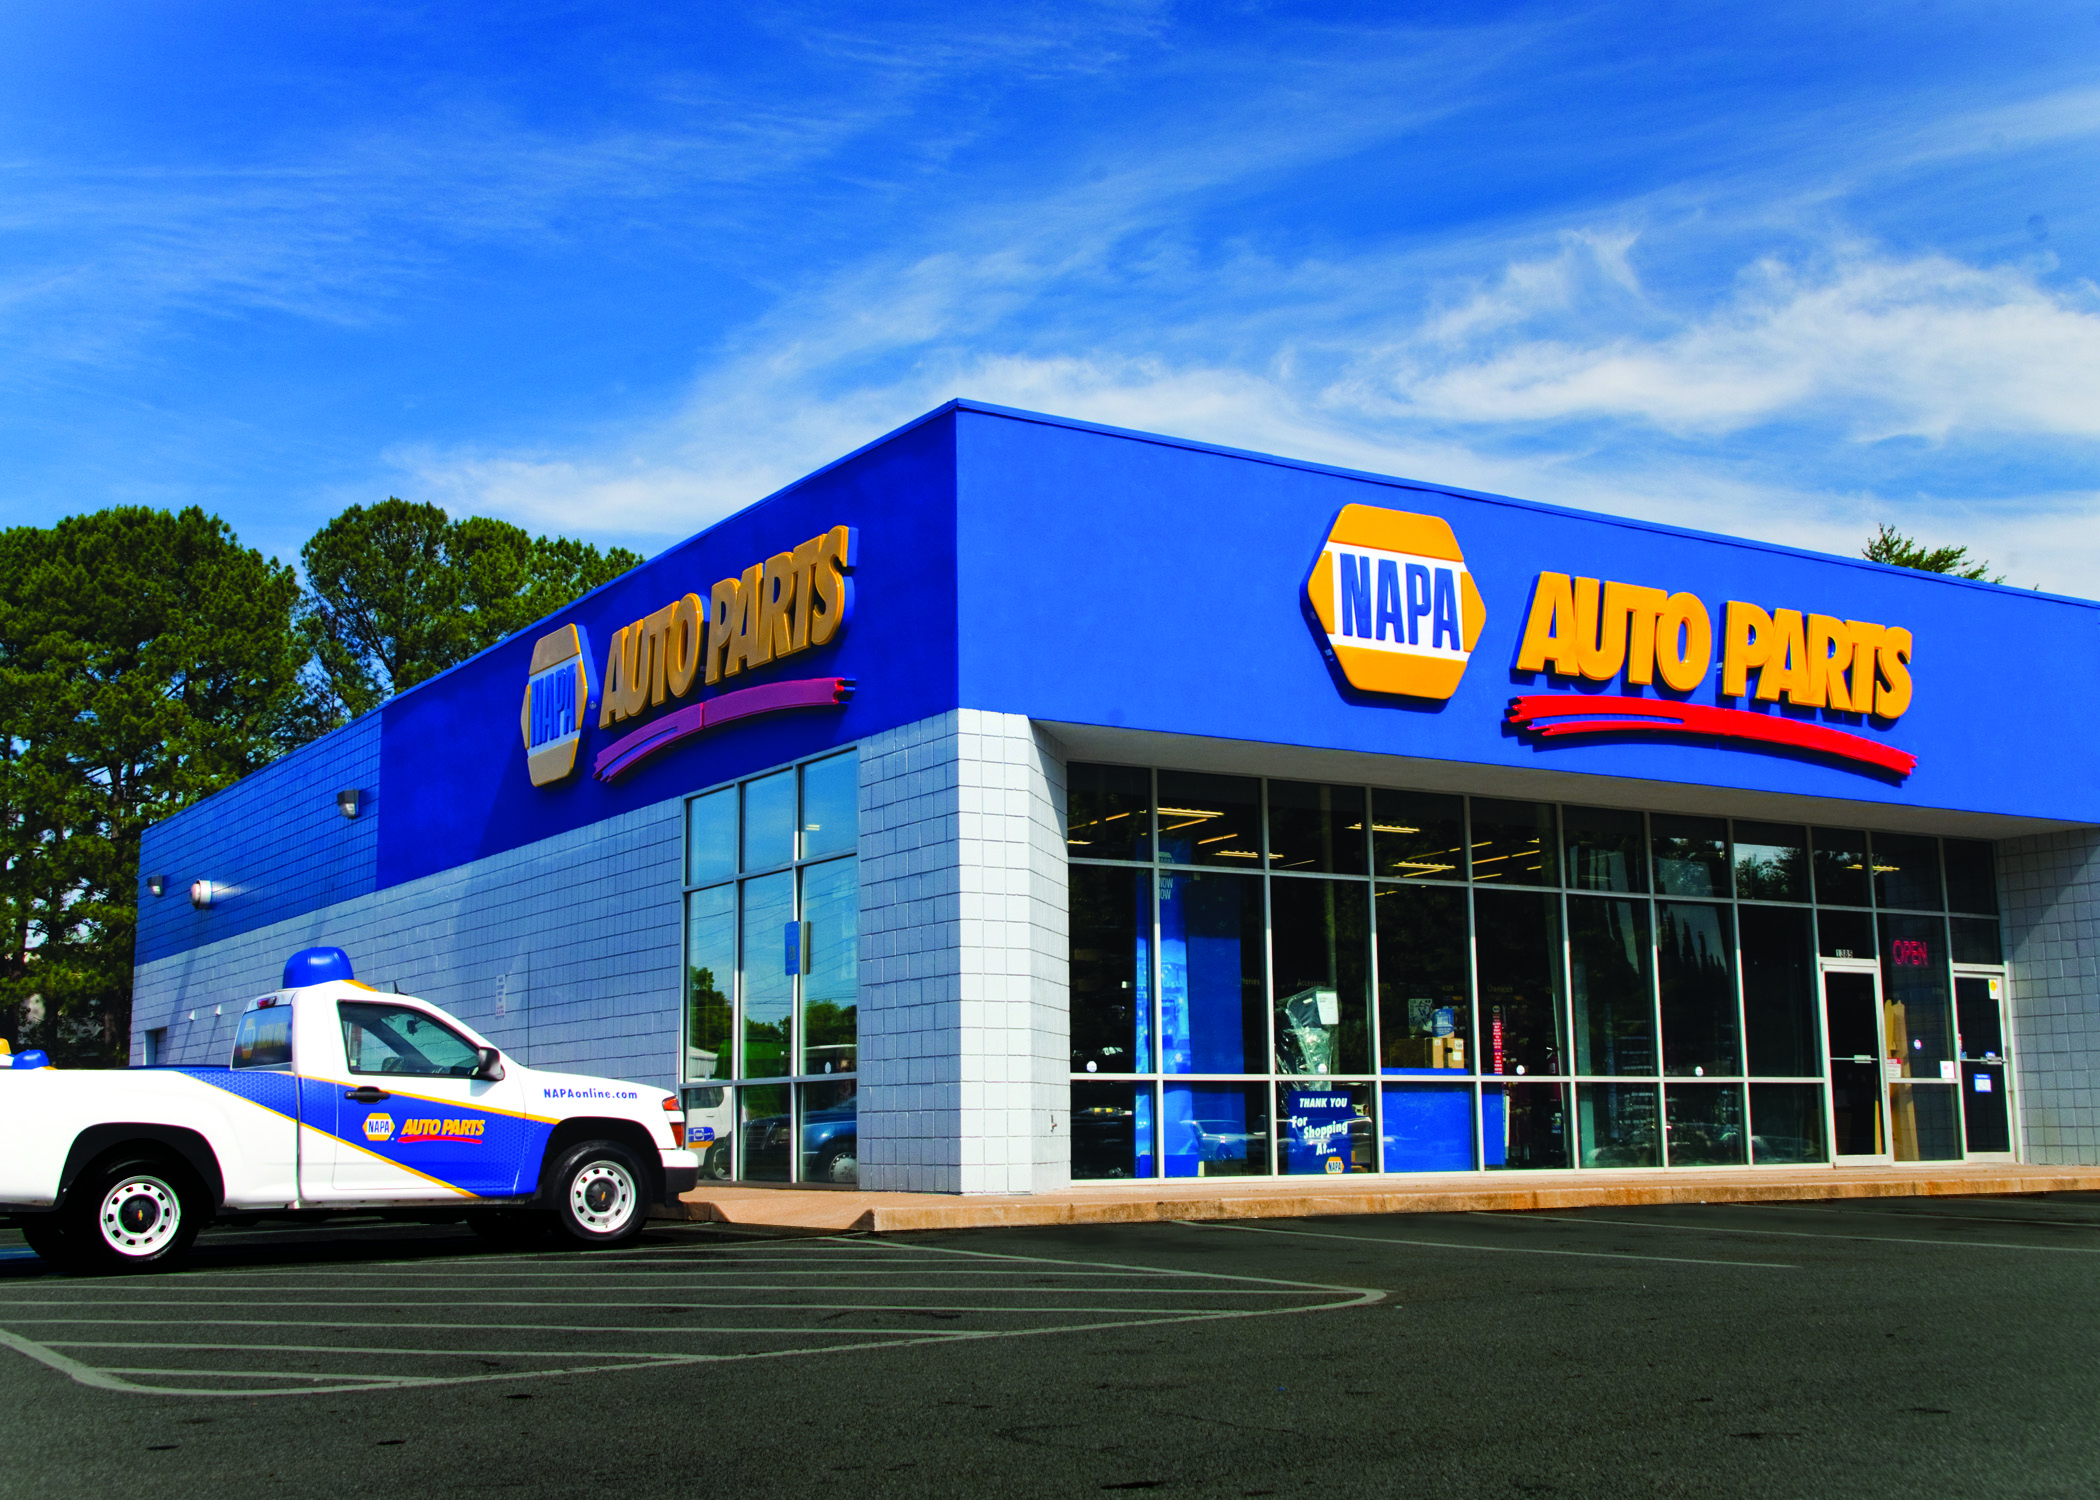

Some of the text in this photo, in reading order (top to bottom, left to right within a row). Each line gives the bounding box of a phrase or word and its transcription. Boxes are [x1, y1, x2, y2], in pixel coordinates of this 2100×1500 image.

[529, 525, 849, 749] NAPA AUTO PARTS
[1340, 553, 1913, 719] NAPA AUTO PARTS
[1893, 940, 1928, 966] OPEN
[543, 1088, 637, 1099] NAPAonline.com
[1299, 1098, 1348, 1108] THANK YOU
[367, 1119, 485, 1135] NAPA AUTO PARTS
[1292, 1115, 1308, 1128] For
[1303, 1120, 1348, 1139] Shopping
[1328, 1161, 1342, 1172] NAPA
